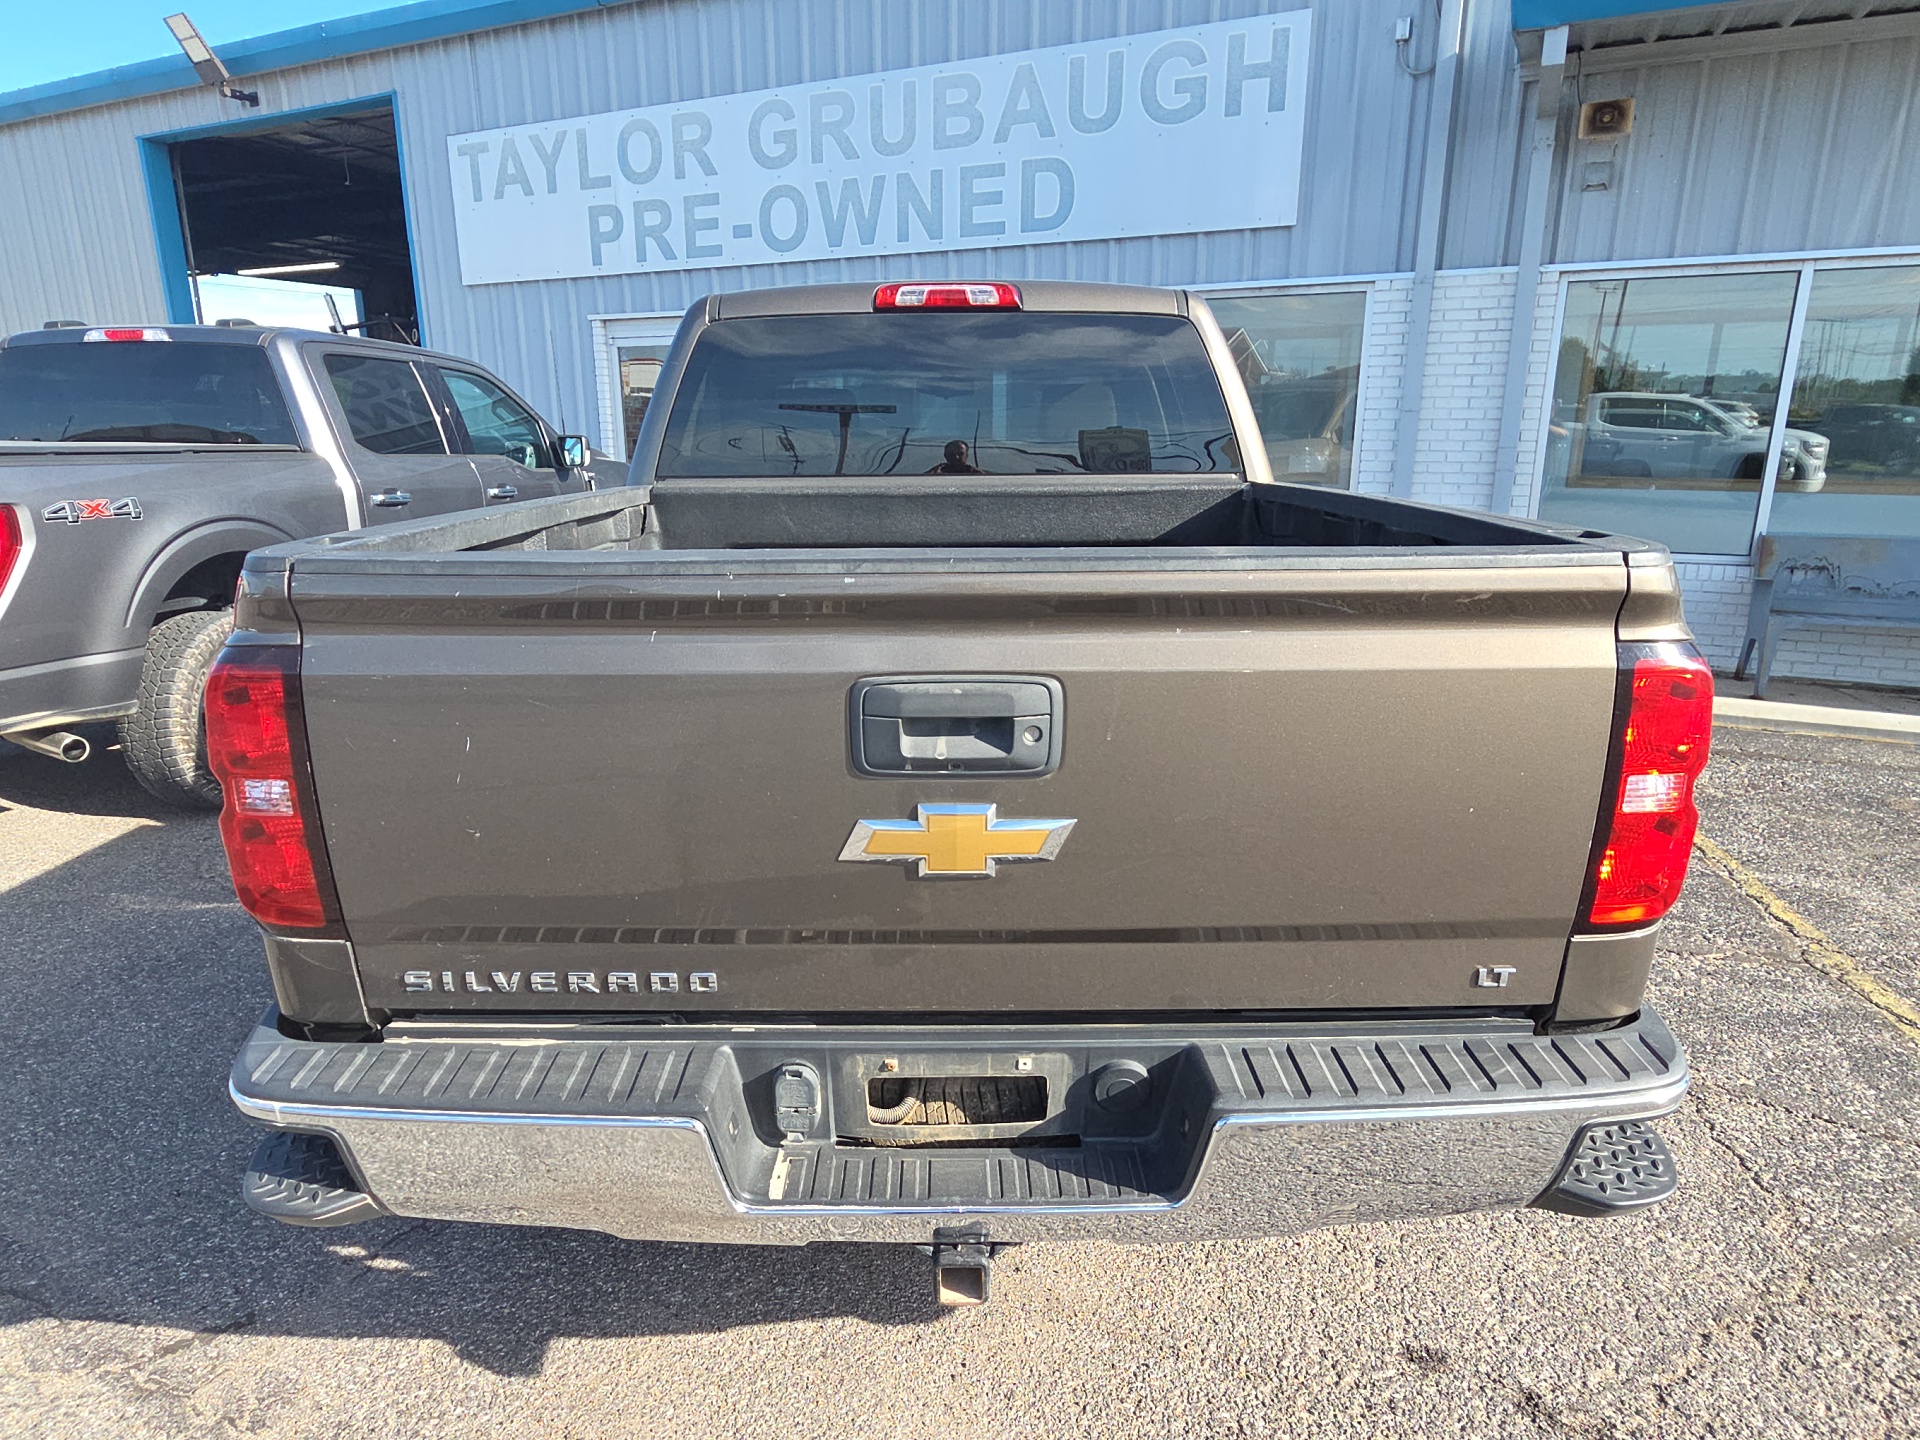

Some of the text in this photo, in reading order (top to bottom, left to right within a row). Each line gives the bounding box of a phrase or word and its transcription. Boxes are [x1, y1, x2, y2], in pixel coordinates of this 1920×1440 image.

[456, 26, 1292, 203] TAYLOR GRUBAUGH
[587, 156, 1076, 267] PRE-OWNED
[403, 970, 718, 993] SILVERADO
[1478, 967, 1517, 987] LT
